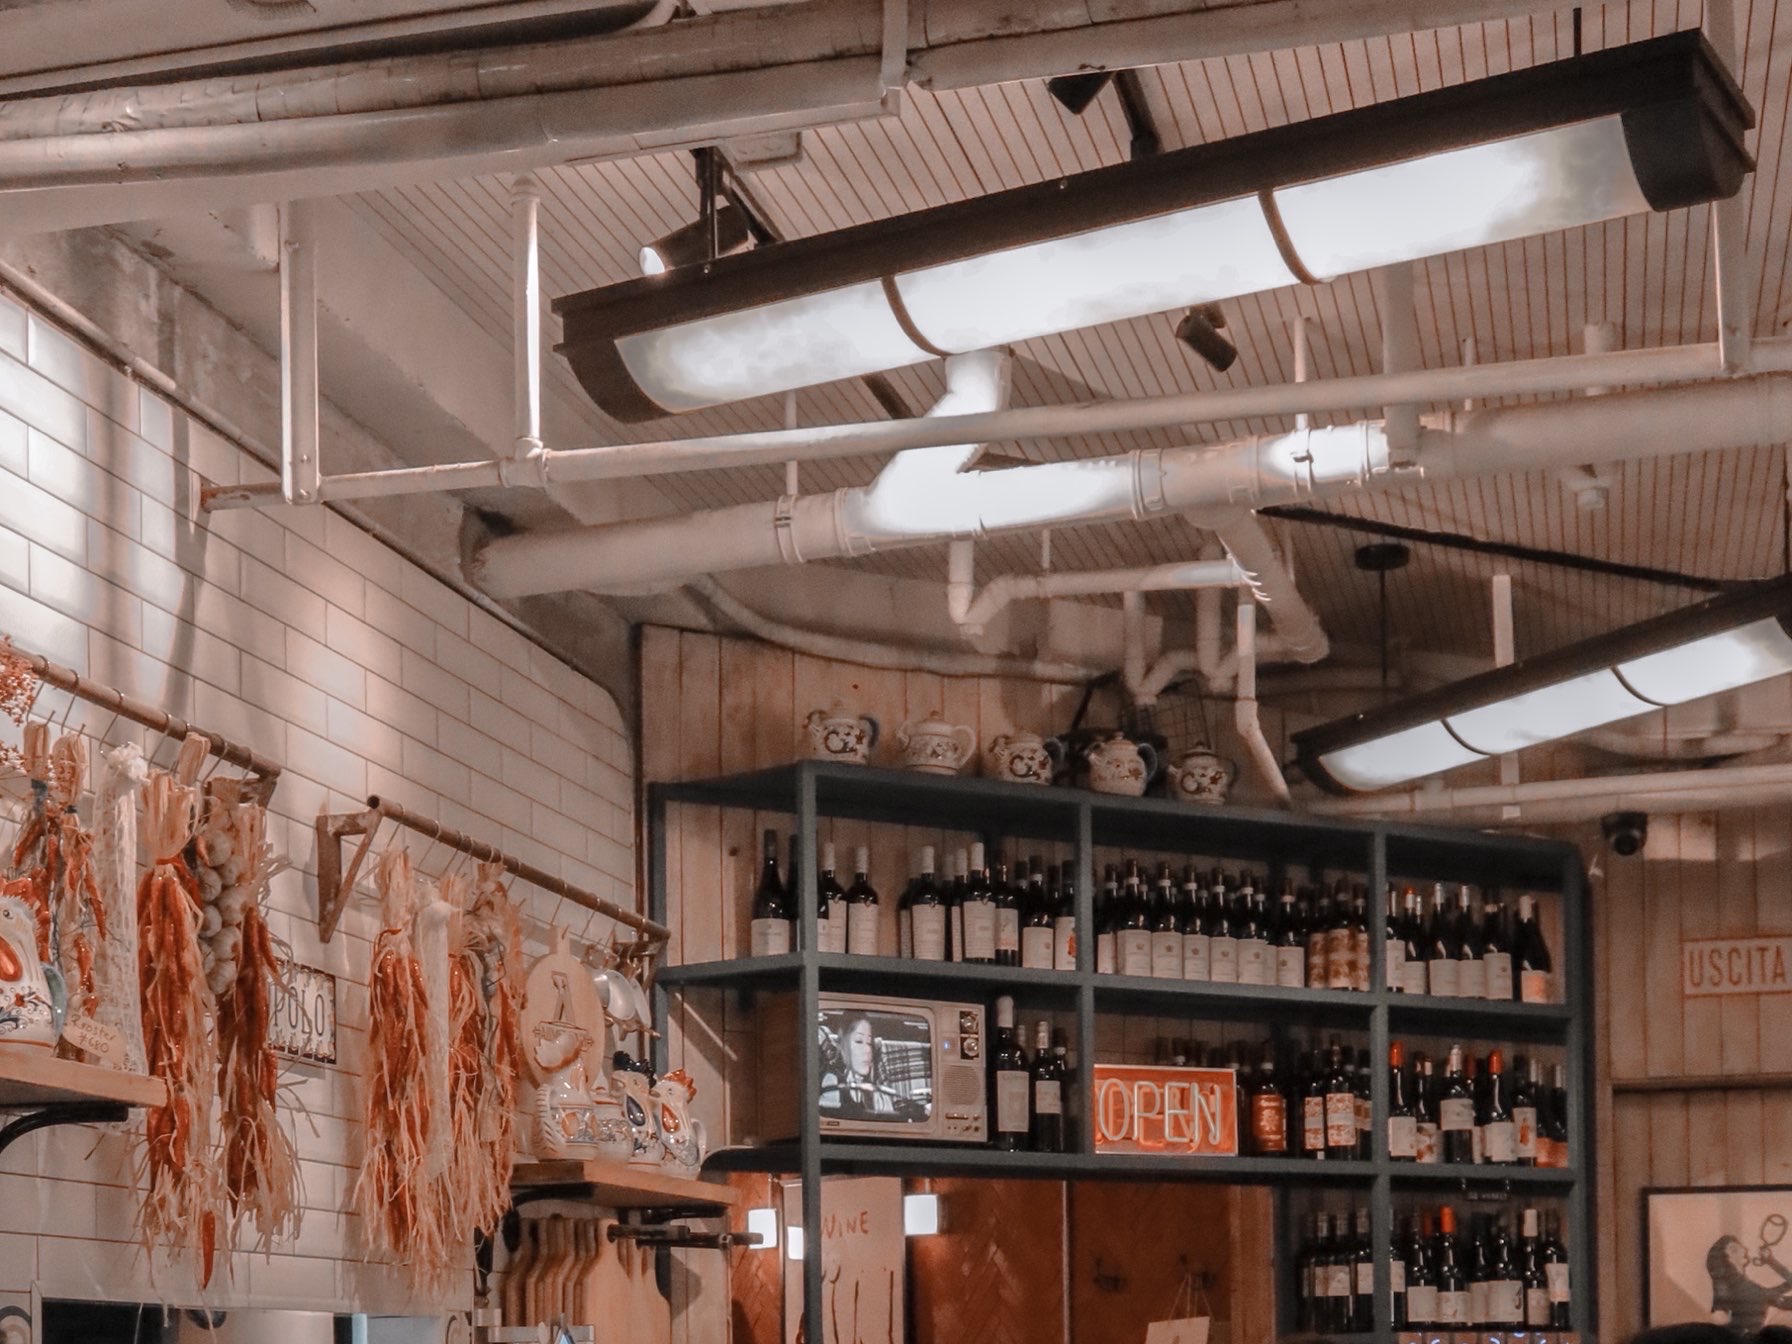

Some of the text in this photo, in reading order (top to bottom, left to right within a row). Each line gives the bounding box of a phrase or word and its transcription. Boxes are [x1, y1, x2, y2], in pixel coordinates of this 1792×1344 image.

[1689, 945, 1786, 988] USCITA
[1099, 1077, 1222, 1146] OPEN
[821, 1211, 869, 1240] WINE
